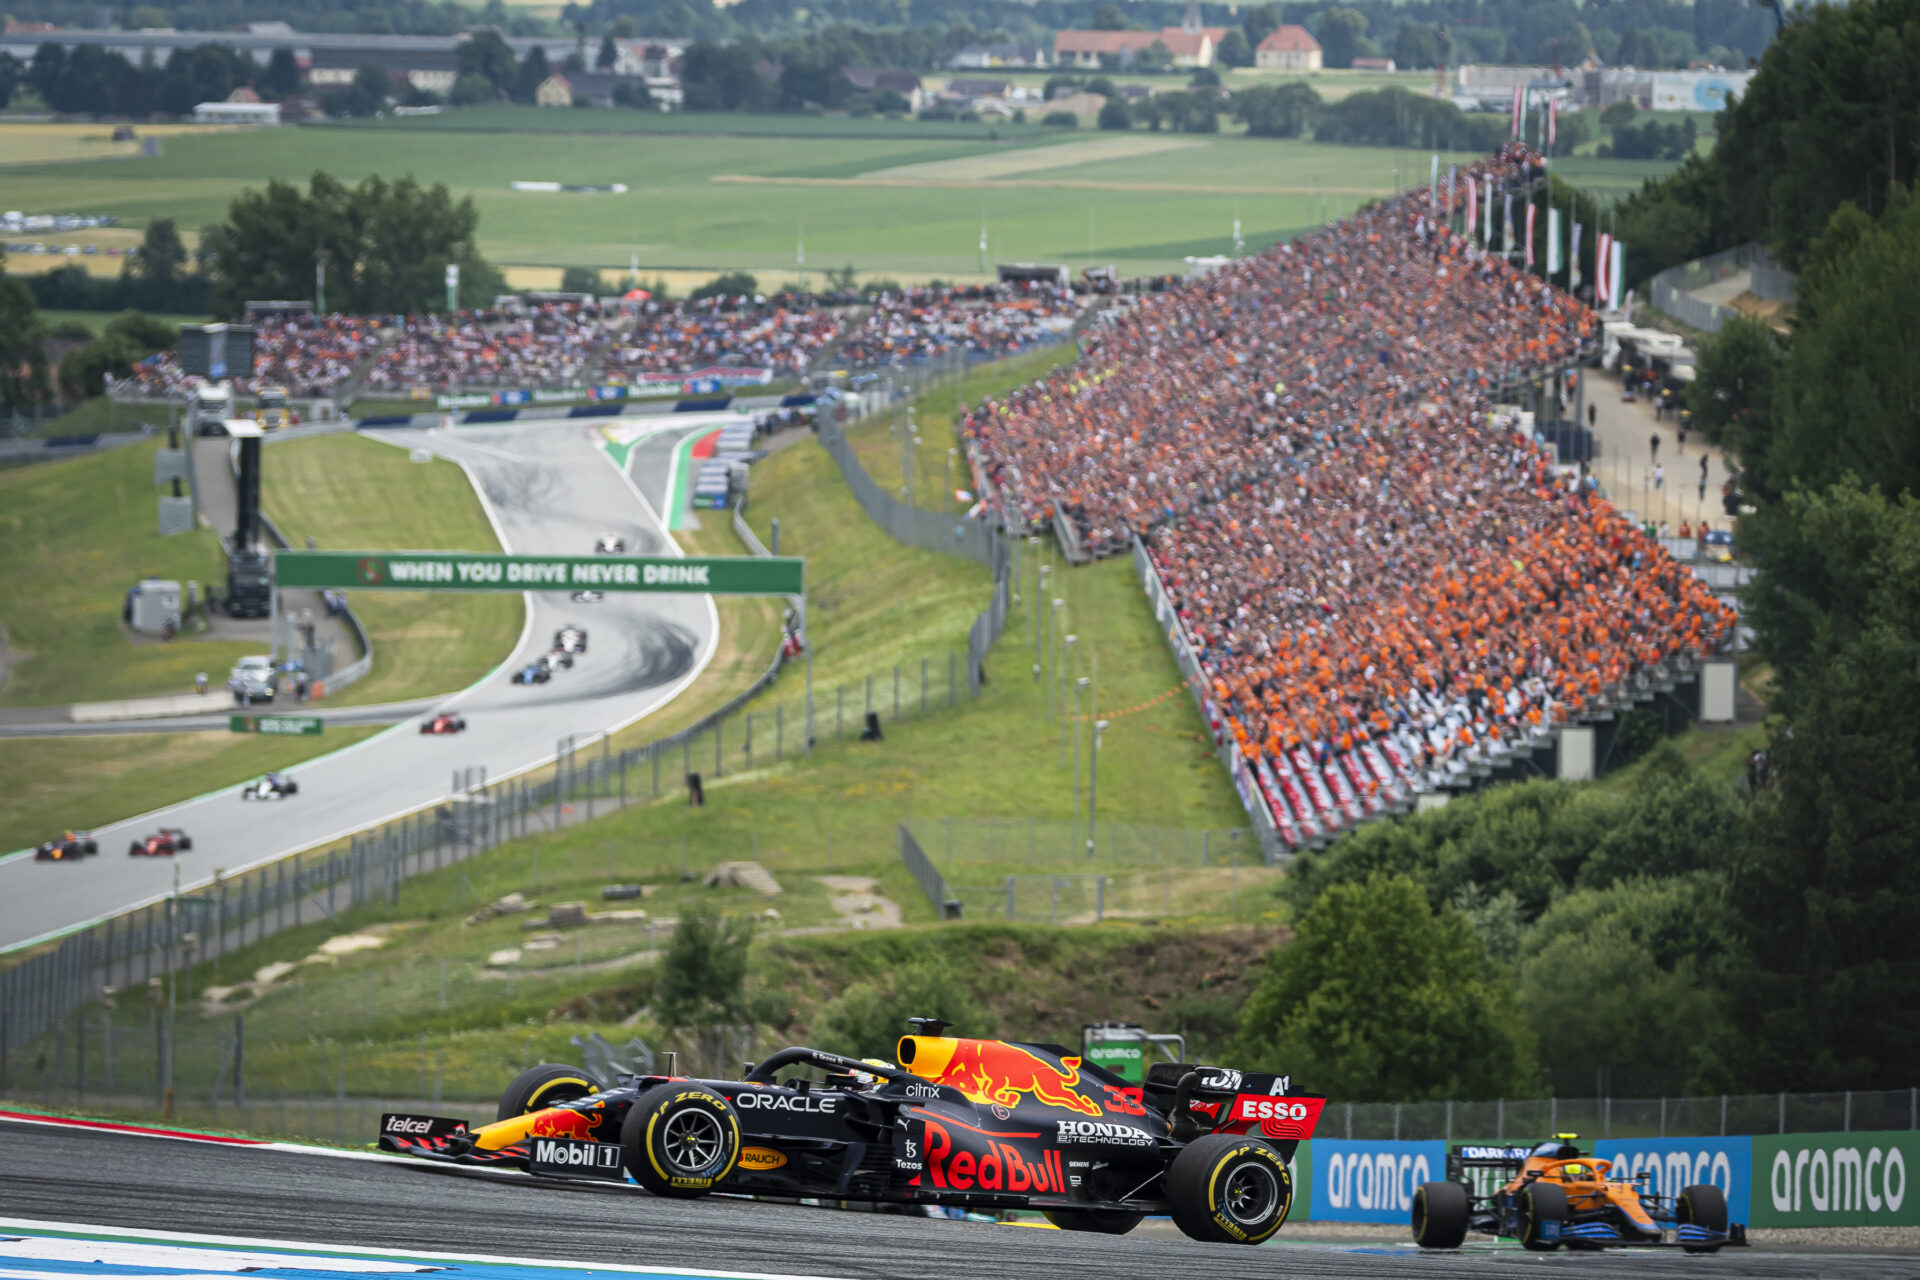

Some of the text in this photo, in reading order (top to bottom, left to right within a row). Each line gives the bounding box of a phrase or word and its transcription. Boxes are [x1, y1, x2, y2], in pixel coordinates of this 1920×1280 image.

[389, 561, 710, 585] WHEN YOU DRIVE NEVER DRINK
[906, 1083, 940, 1099] citrix
[660, 1091, 727, 1115] P ZERO
[736, 1093, 836, 1113] ORACLE
[1243, 1101, 1307, 1120] ESSO
[386, 1116, 434, 1134] telcel
[1057, 1120, 1153, 1139] HONDA
[536, 1140, 595, 1166] Mobil
[744, 1152, 781, 1164] RAUCH
[896, 1158, 923, 1170] Tezos
[1254, 1147, 1290, 1185] ZERO
[1328, 1152, 1430, 1212] aramco
[1771, 1147, 1906, 1212] aramco
